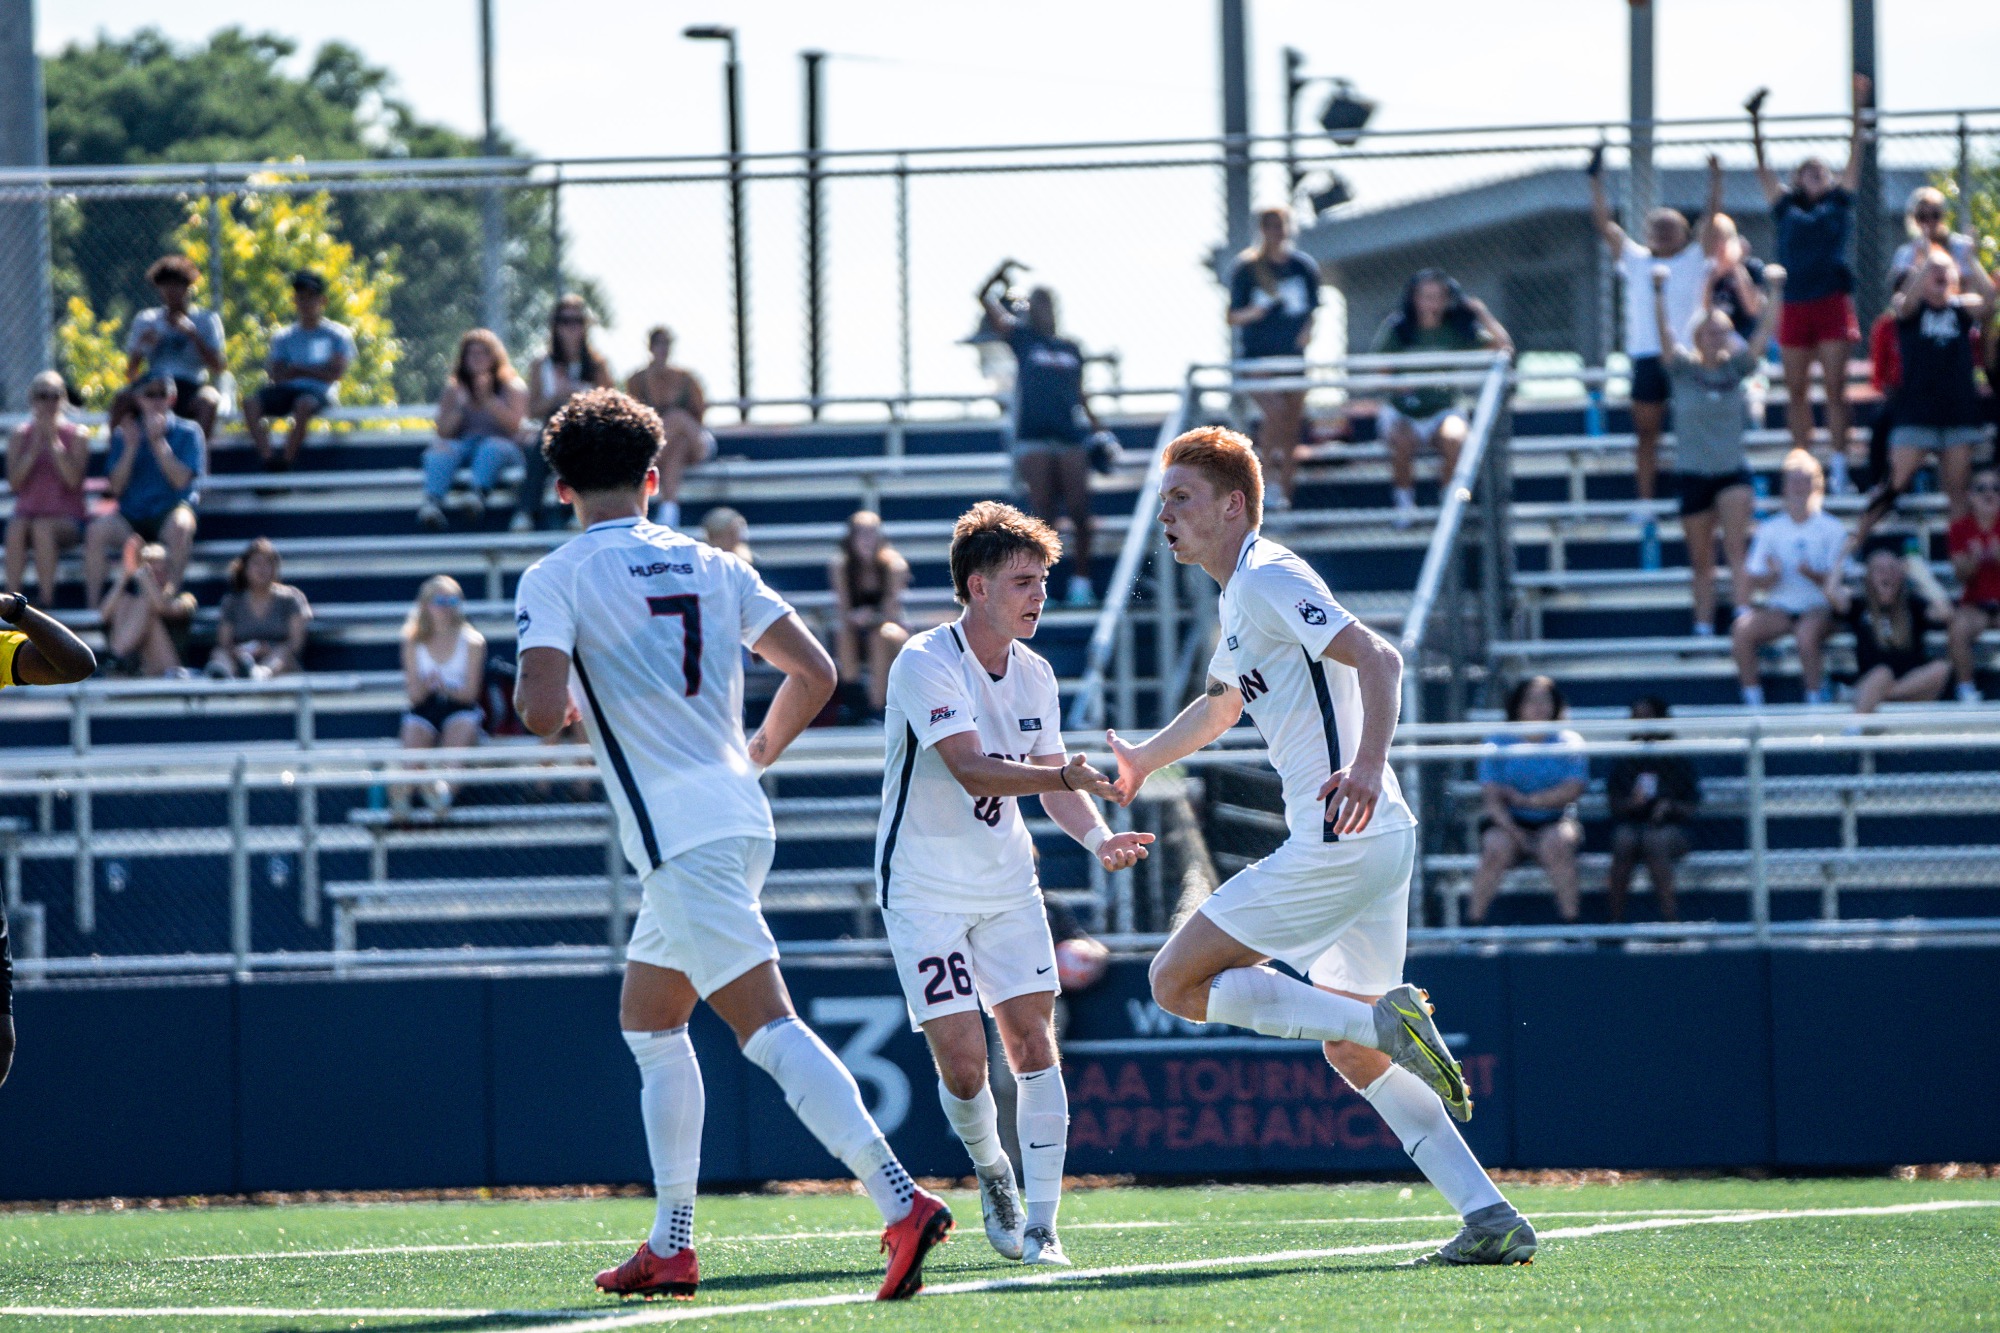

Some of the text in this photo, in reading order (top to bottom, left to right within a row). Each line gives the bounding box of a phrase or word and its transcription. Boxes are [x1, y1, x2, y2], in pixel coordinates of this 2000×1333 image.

[629, 562, 694, 577] HUSKES
[646, 593, 703, 697] 7
[930, 710, 956, 722] EAST
[931, 705, 949, 715] BIG
[918, 952, 973, 1005] 26
